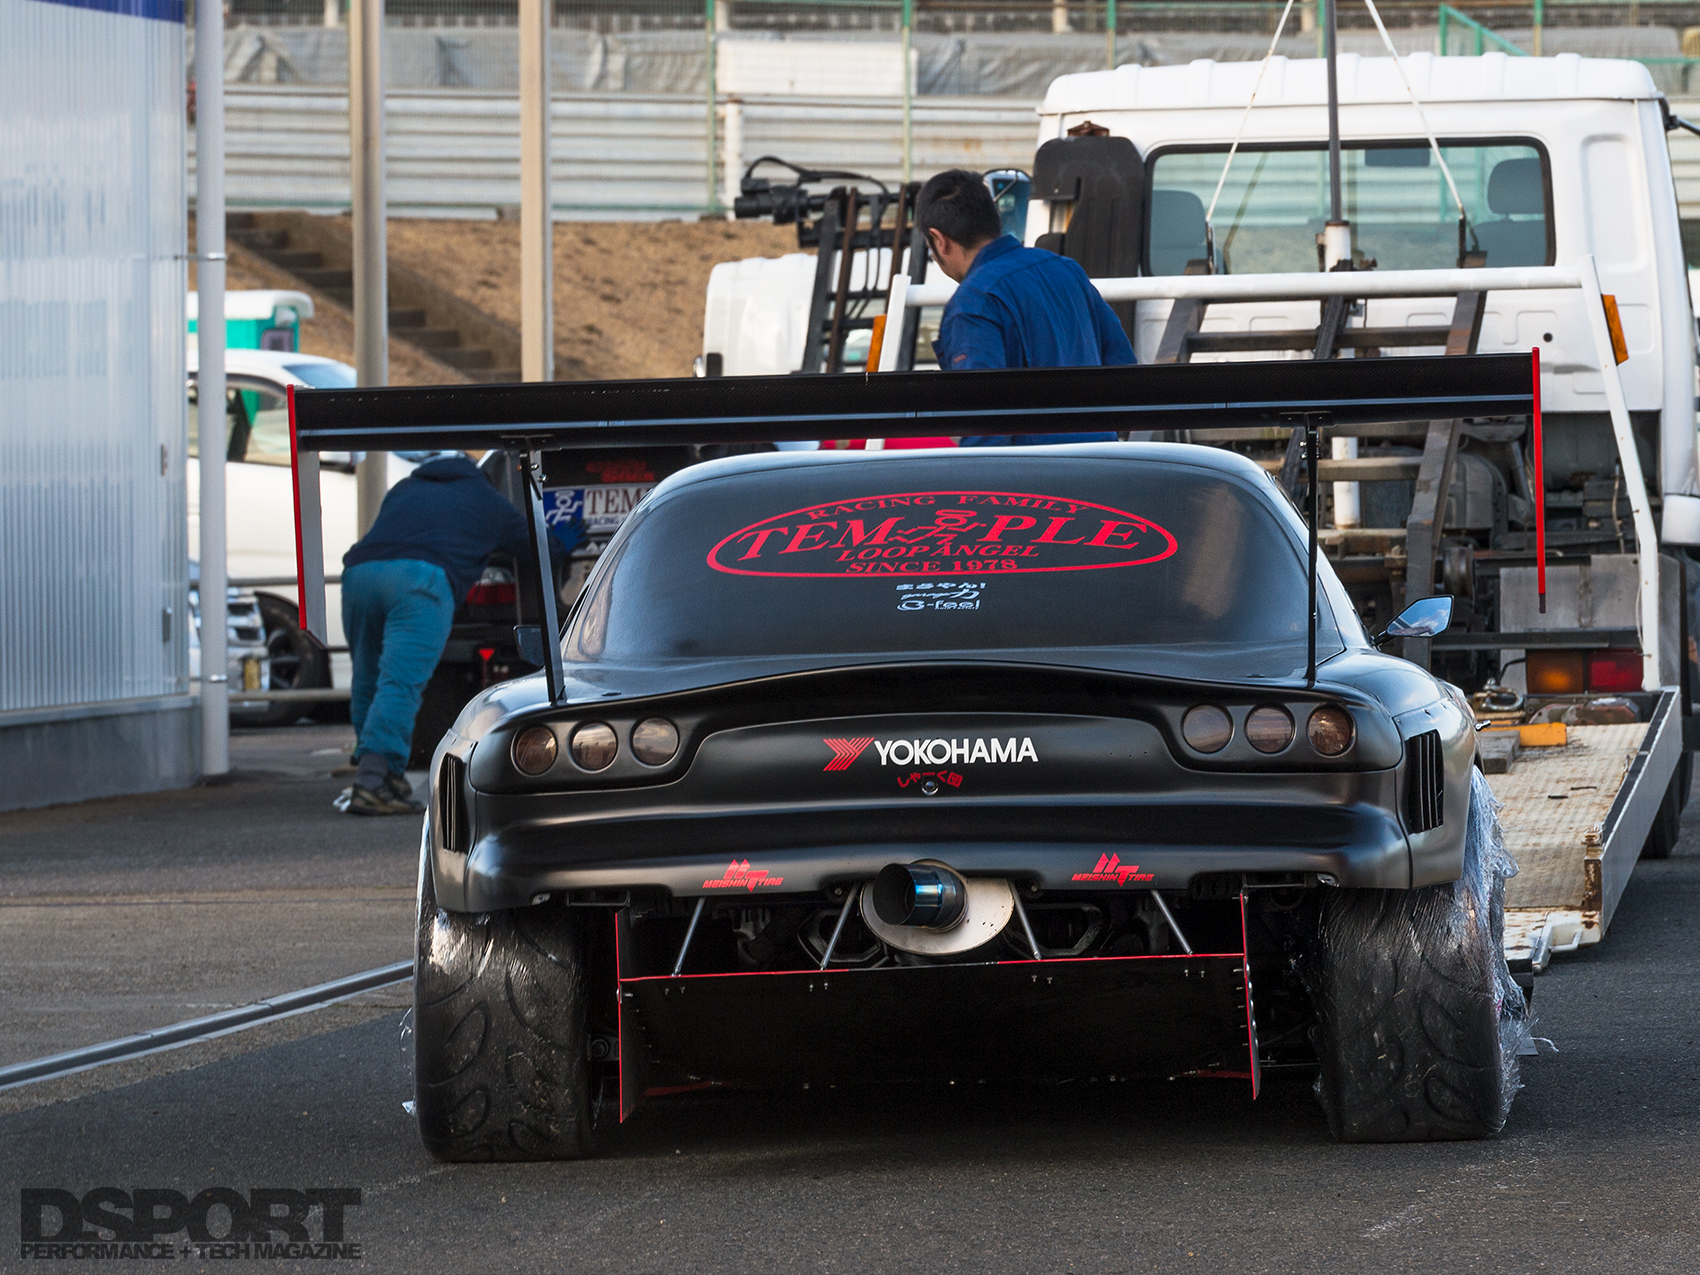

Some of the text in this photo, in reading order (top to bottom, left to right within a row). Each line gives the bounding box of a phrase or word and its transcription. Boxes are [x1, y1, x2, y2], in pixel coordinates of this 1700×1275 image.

[586, 489, 652, 515] TEM
[805, 496, 1089, 520] RACING FAMILY
[835, 545, 1039, 562] LOOP ANGEL
[846, 559, 1018, 573] SINCE 1978
[874, 737, 1039, 766] YOKOHAMA
